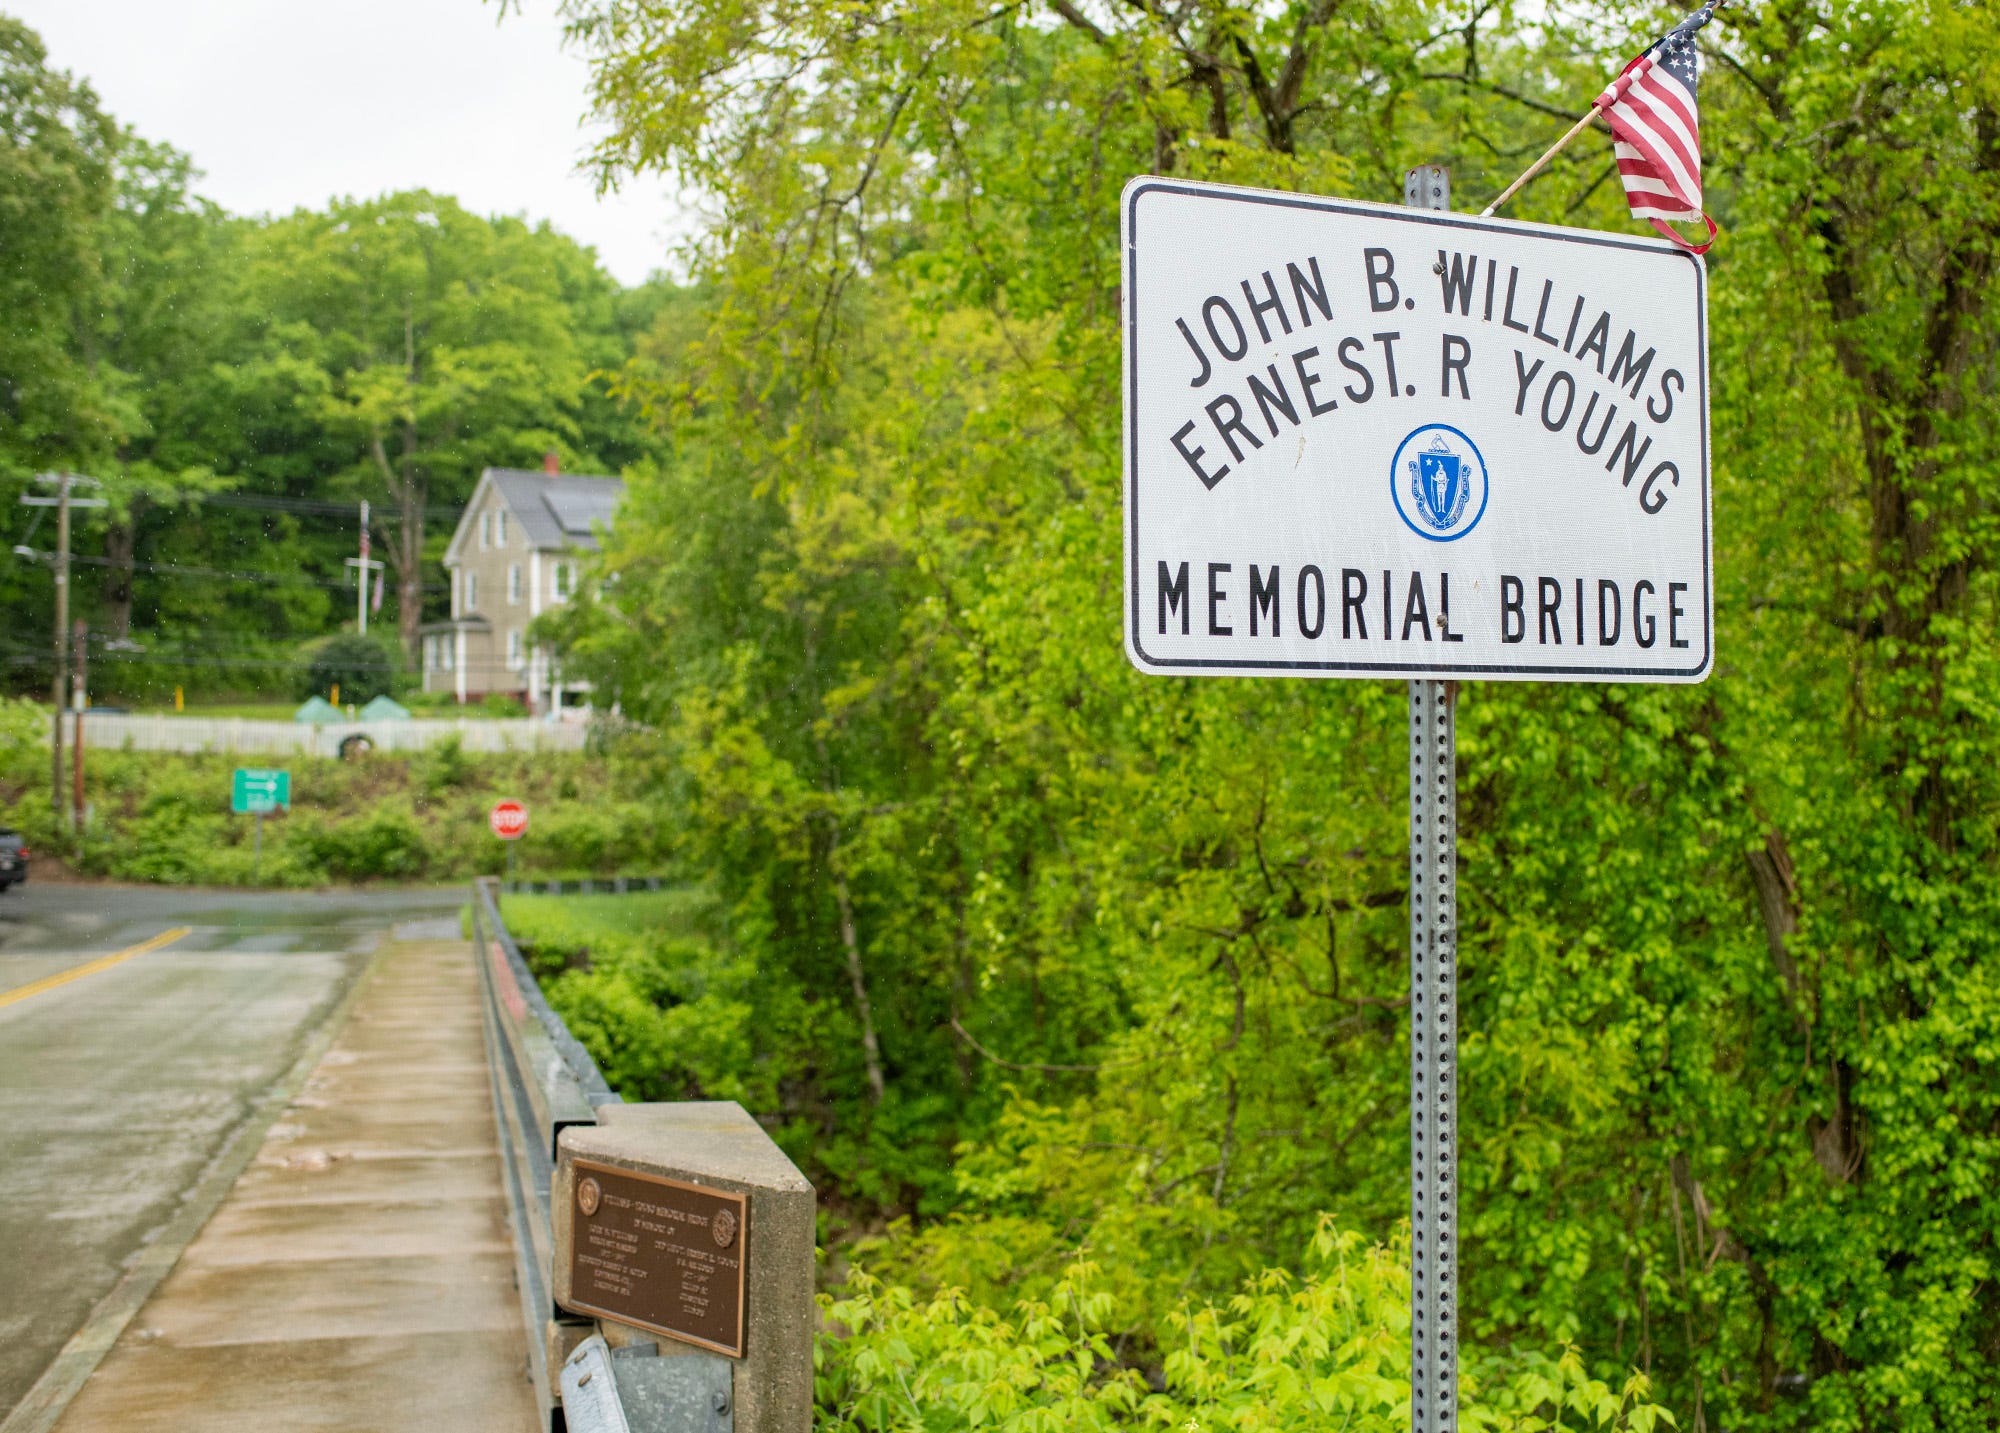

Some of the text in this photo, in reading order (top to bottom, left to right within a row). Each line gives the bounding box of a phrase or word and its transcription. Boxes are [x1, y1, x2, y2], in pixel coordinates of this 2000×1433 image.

[1175, 248, 1685, 423] JOHN B. WILLIAMS
[1442, 334, 1472, 400] R
[1514, 350, 1680, 515] YOUNG
[1158, 561, 1689, 648] MEMORIAL BRIDGE
[491, 810, 528, 827] STOP
